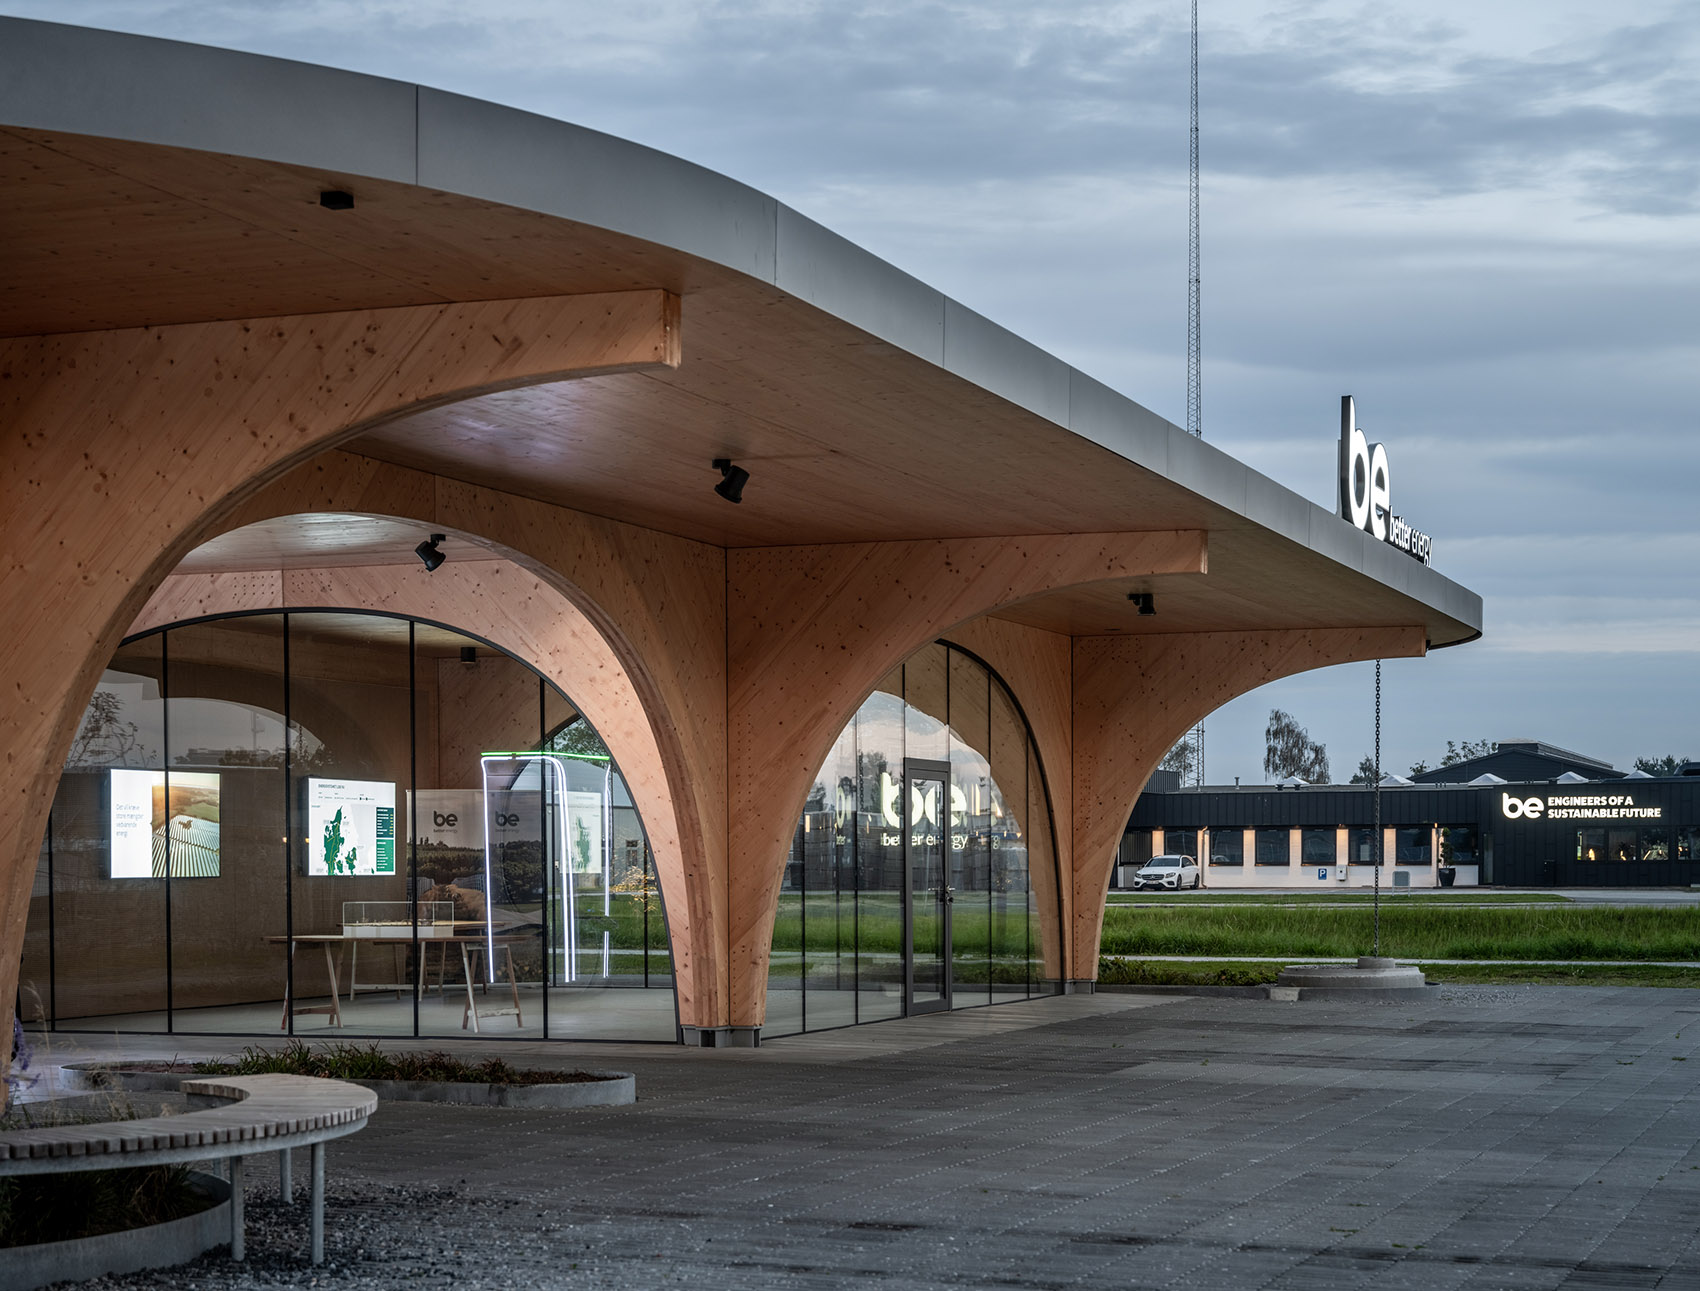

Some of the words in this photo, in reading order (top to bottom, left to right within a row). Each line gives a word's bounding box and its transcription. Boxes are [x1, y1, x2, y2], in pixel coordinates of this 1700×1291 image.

[1342, 395, 1390, 541] be
[1389, 505, 1411, 550] better
[1411, 529, 1433, 568] energy
[1502, 792, 1544, 819] be
[1547, 796, 1607, 806] ENGINEERS
[1608, 796, 1625, 806] OF
[1625, 796, 1634, 806] A
[433, 810, 458, 827] be
[495, 810, 520, 827] be
[1547, 808, 1619, 819] SUSTAINABLE
[1619, 808, 1662, 818] FUTURE
[882, 833, 924, 847] beer
[1319, 869, 1326, 878] P
